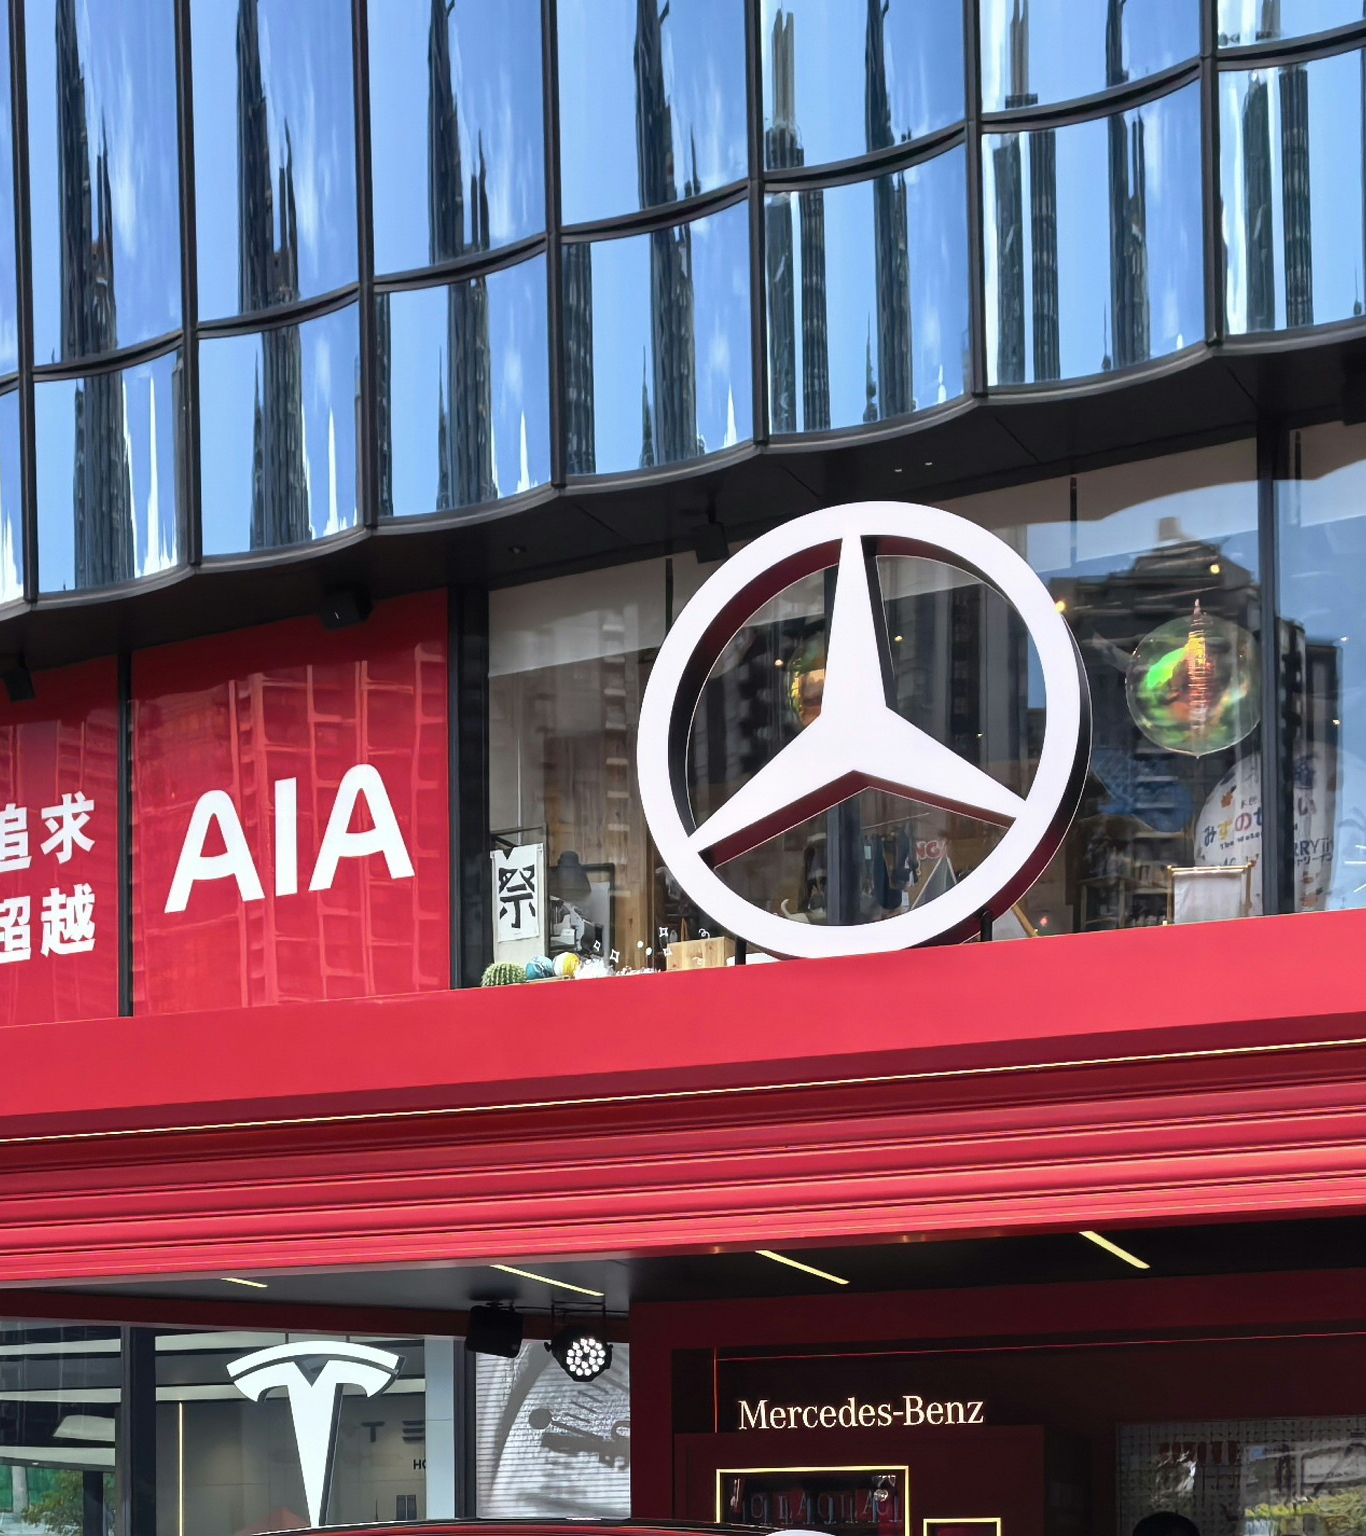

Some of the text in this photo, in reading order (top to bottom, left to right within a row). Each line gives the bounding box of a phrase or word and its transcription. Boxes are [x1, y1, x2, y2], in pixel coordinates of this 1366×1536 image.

[164, 764, 415, 914] AIA
[498, 864, 537, 929] 祭
[737, 1394, 985, 1430] Mercedes-Benz
